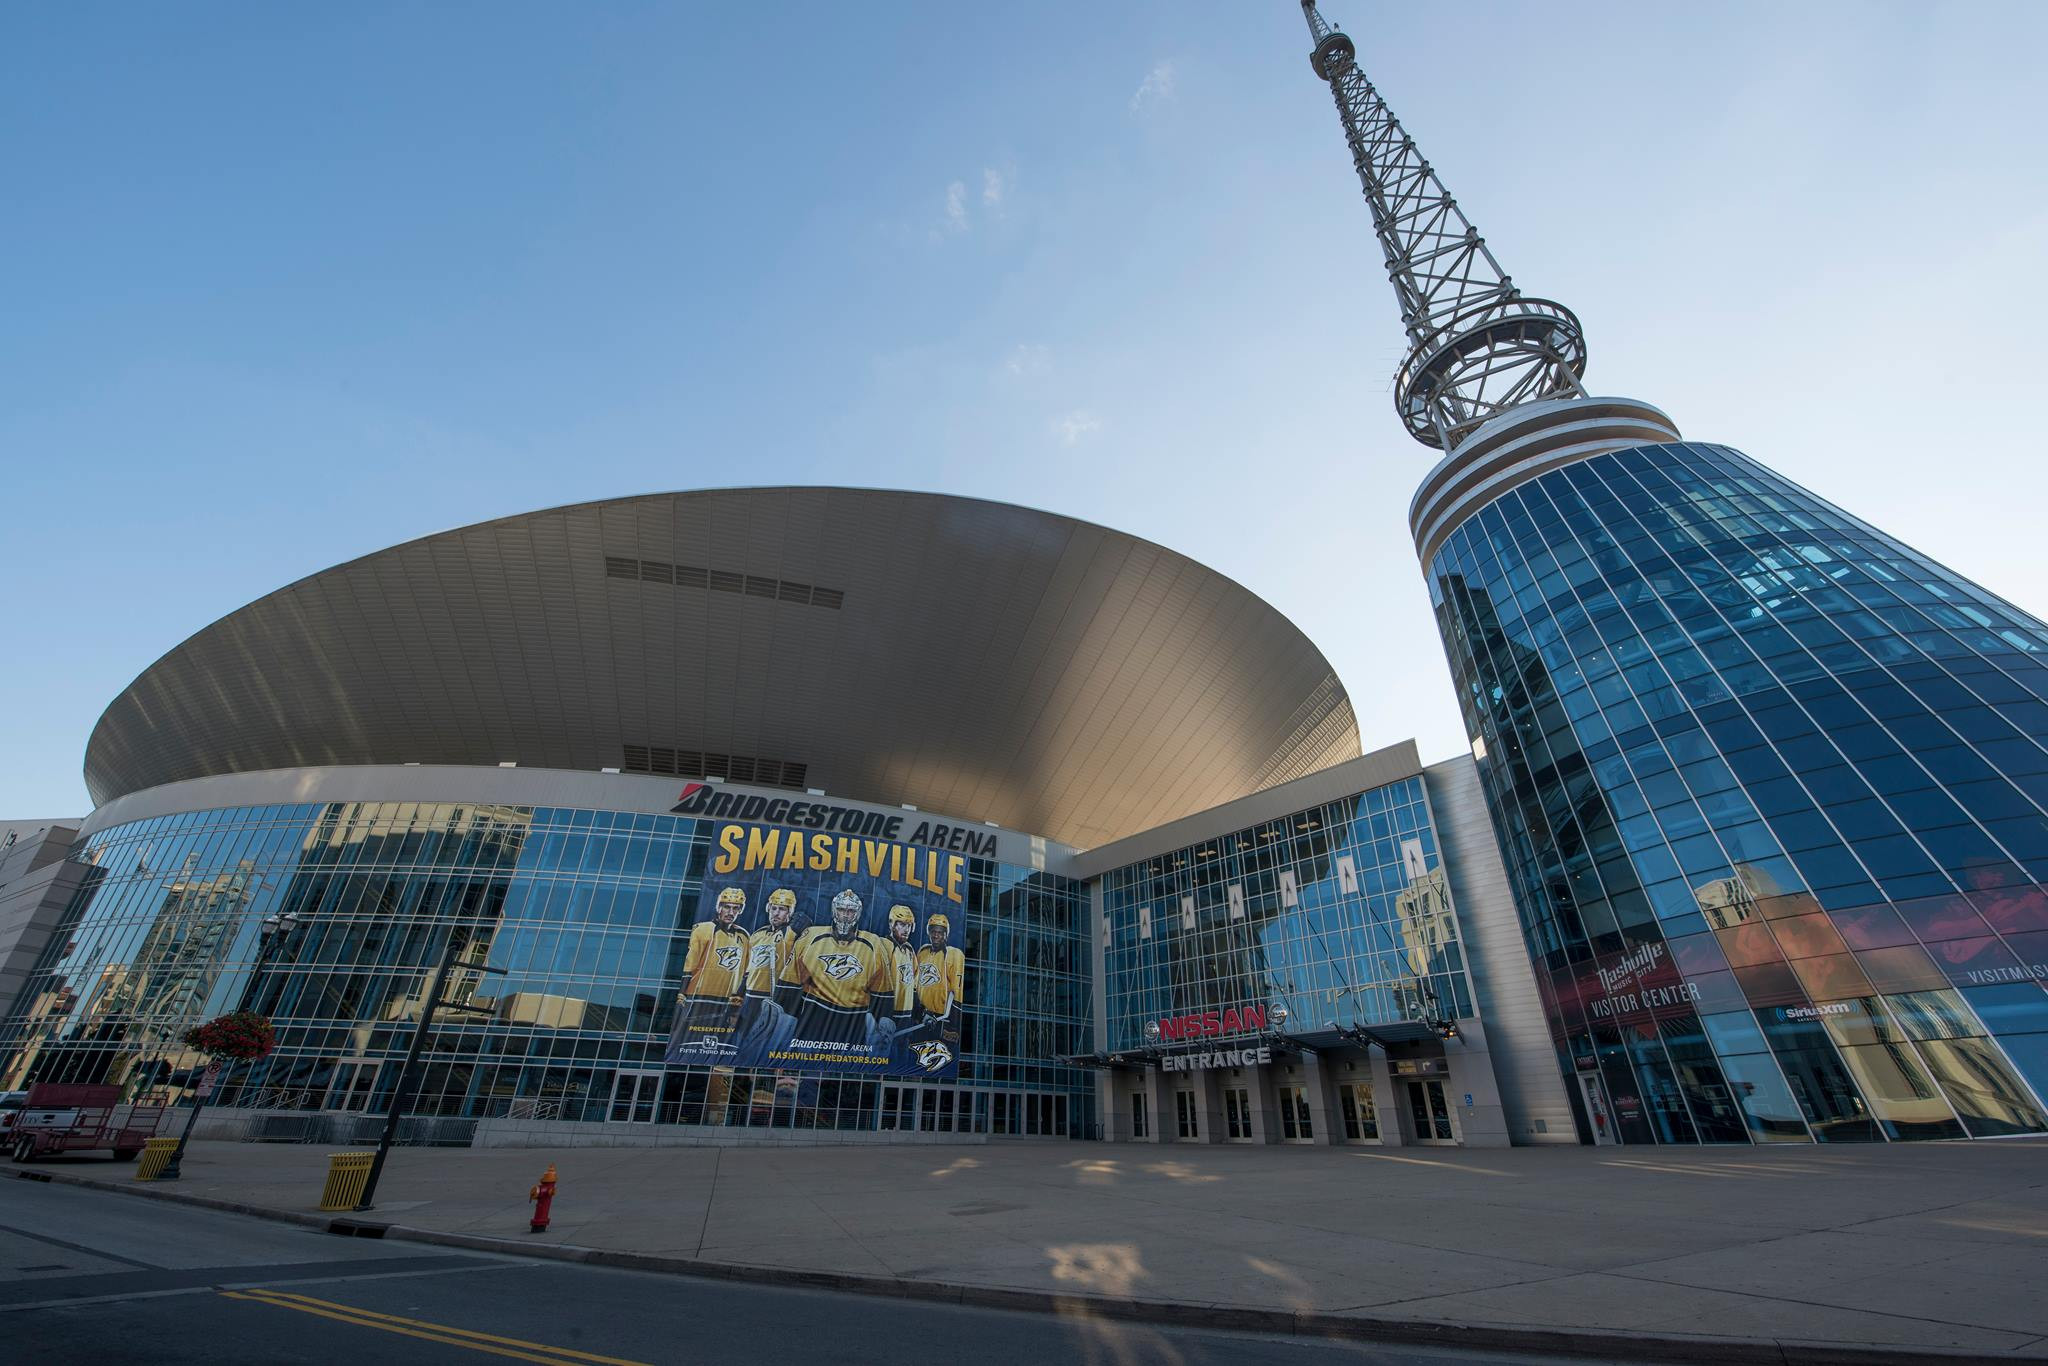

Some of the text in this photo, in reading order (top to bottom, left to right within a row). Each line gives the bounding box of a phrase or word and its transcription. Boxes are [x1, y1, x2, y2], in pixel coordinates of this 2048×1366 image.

[671, 783, 998, 858] BRIDGESTONE ARENA
[714, 824, 964, 904] SMASHVILLE
[1612, 964, 1653, 991] MUSIC CITY
[1590, 982, 1702, 1018] VISITOR CENTER
[688, 1025, 726, 1033] PRESENTED
[1159, 1004, 1267, 1041] NISSAN
[768, 1051, 889, 1065] NASHVILLEPREDATORS.COM
[789, 1038, 873, 1053] BRIDGESTONE ARENA
[1162, 1047, 1272, 1072] ENTRANCE
